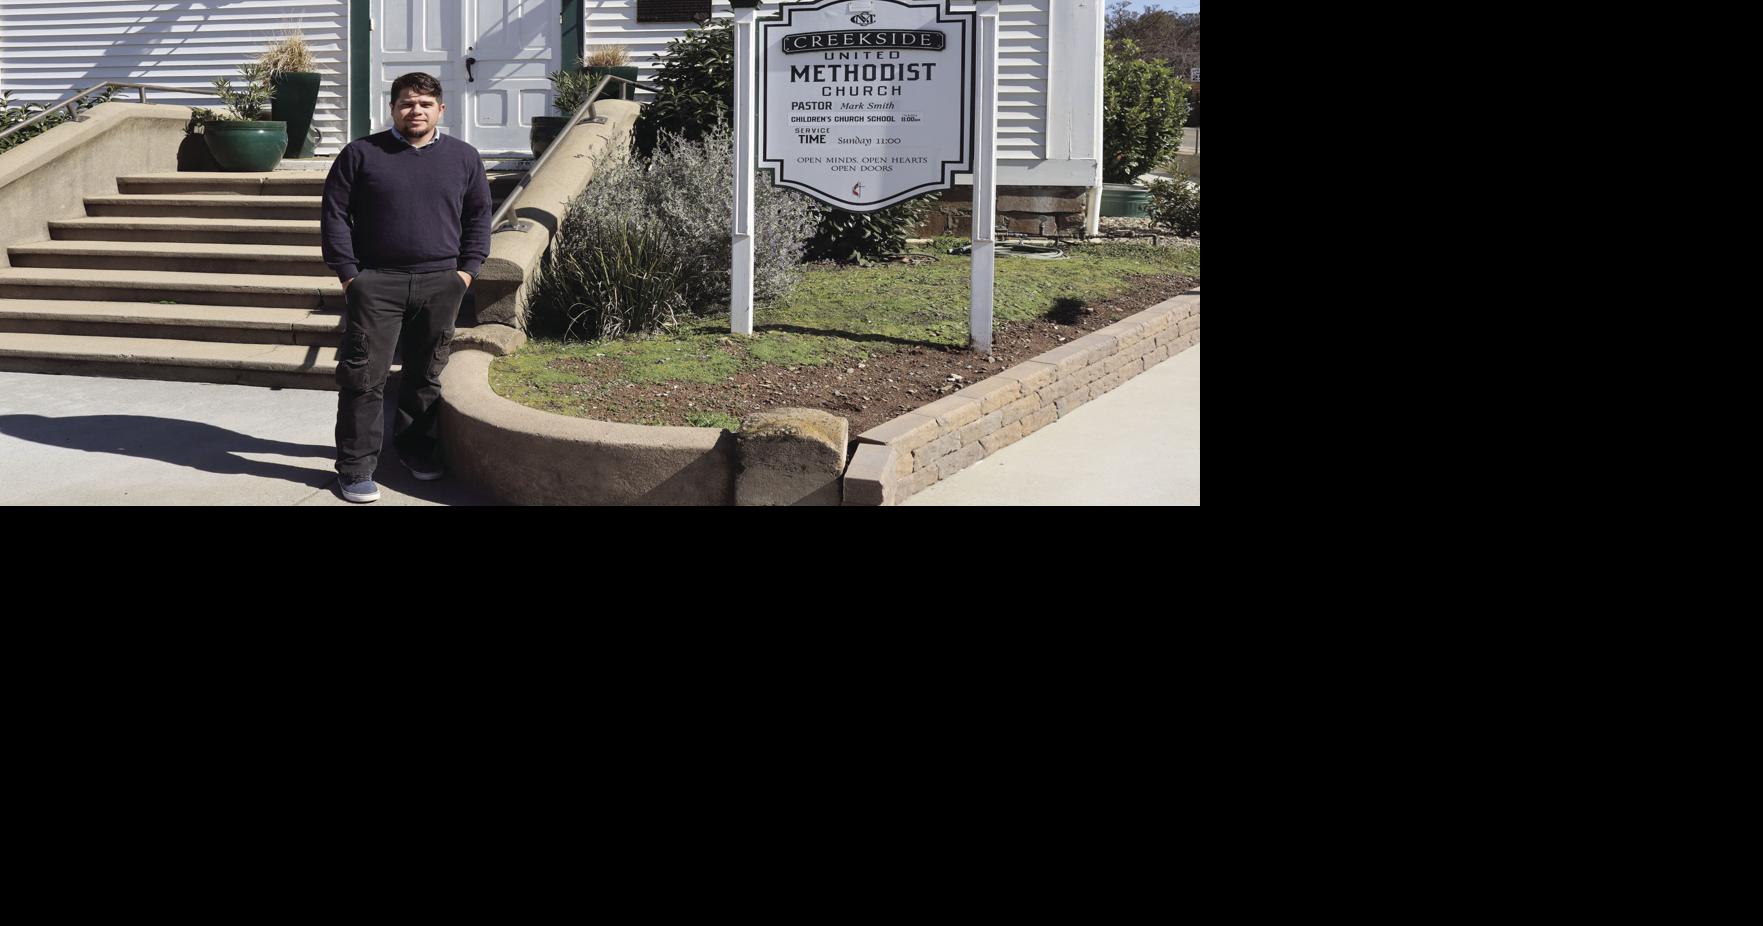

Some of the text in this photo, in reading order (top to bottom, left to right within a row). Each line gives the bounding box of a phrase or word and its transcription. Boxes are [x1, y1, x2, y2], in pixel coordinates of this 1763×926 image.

[793, 32, 931, 49] CREEKSIDE
[824, 50, 900, 61] UNITED
[790, 63, 936, 82] METHODIST
[821, 85, 902, 97] CHURCH
[791, 101, 895, 111] PASTOR Mark Smith
[790, 115, 832, 123] CHILDREN'S
[834, 115, 865, 123] CHURCH
[867, 115, 896, 123] SCHOOL
[799, 134, 826, 144] TIME
[837, 136, 872, 146] Sunday
[796, 156, 822, 164] OPEN
[861, 156, 888, 164] OPEN
[891, 156, 928, 164] HEARTS
[831, 164, 894, 172] OPEN DOORS
